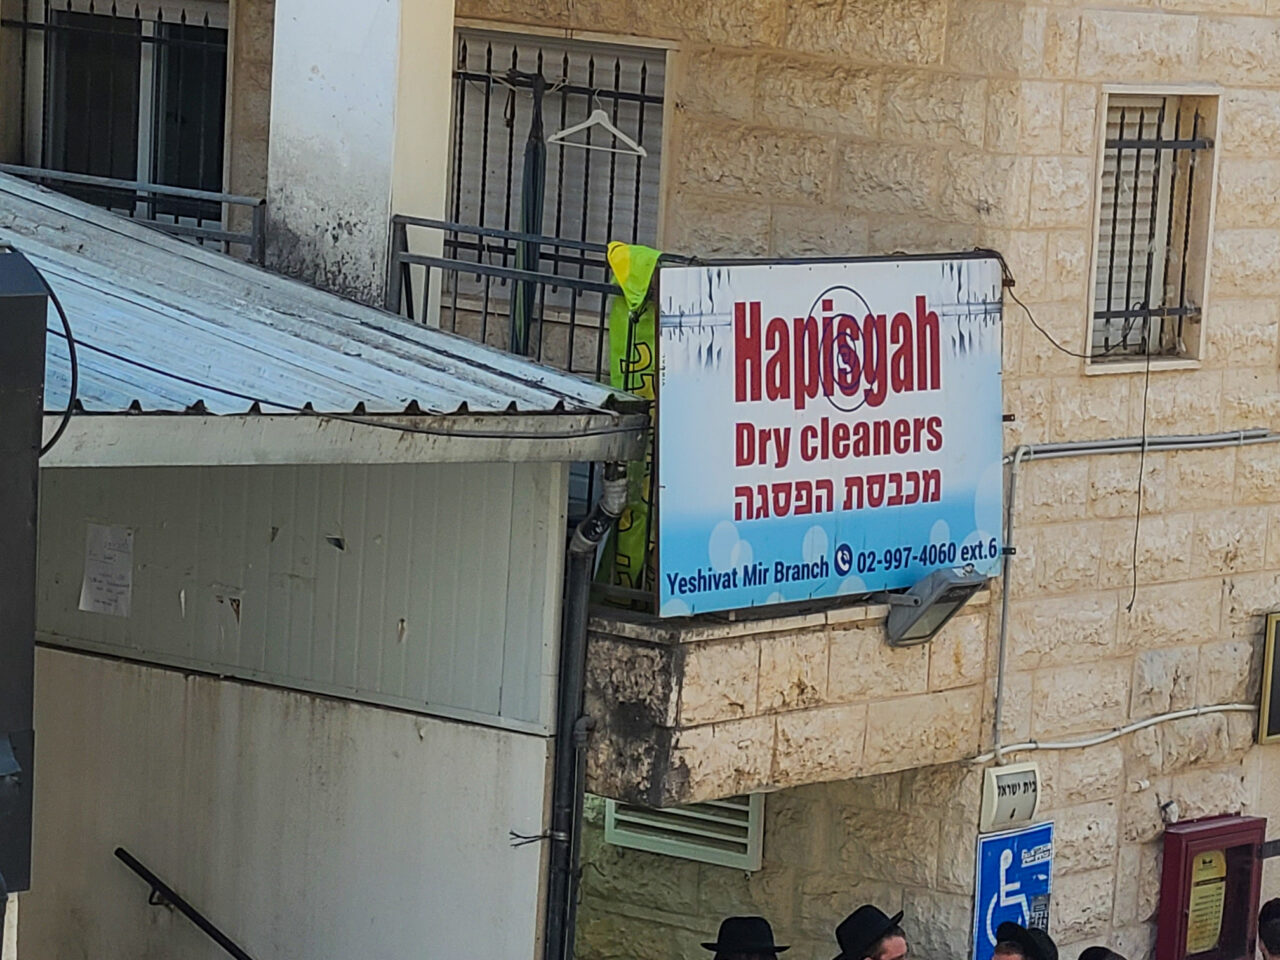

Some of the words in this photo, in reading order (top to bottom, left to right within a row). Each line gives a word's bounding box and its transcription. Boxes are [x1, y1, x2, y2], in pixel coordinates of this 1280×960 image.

[734, 295, 941, 410] Hapisgah
[734, 420, 791, 468] Dry
[799, 415, 943, 461] cleaners
[734, 478, 834, 521] הפסגה
[842, 468, 942, 511] מכבסת
[666, 568, 738, 596] Yeshivat
[743, 561, 769, 585] Mir
[773, 555, 829, 582] Branch
[856, 541, 956, 574] 02-997-4060
[961, 537, 998, 562] ext.6
[1022, 780, 1037, 795] בית
